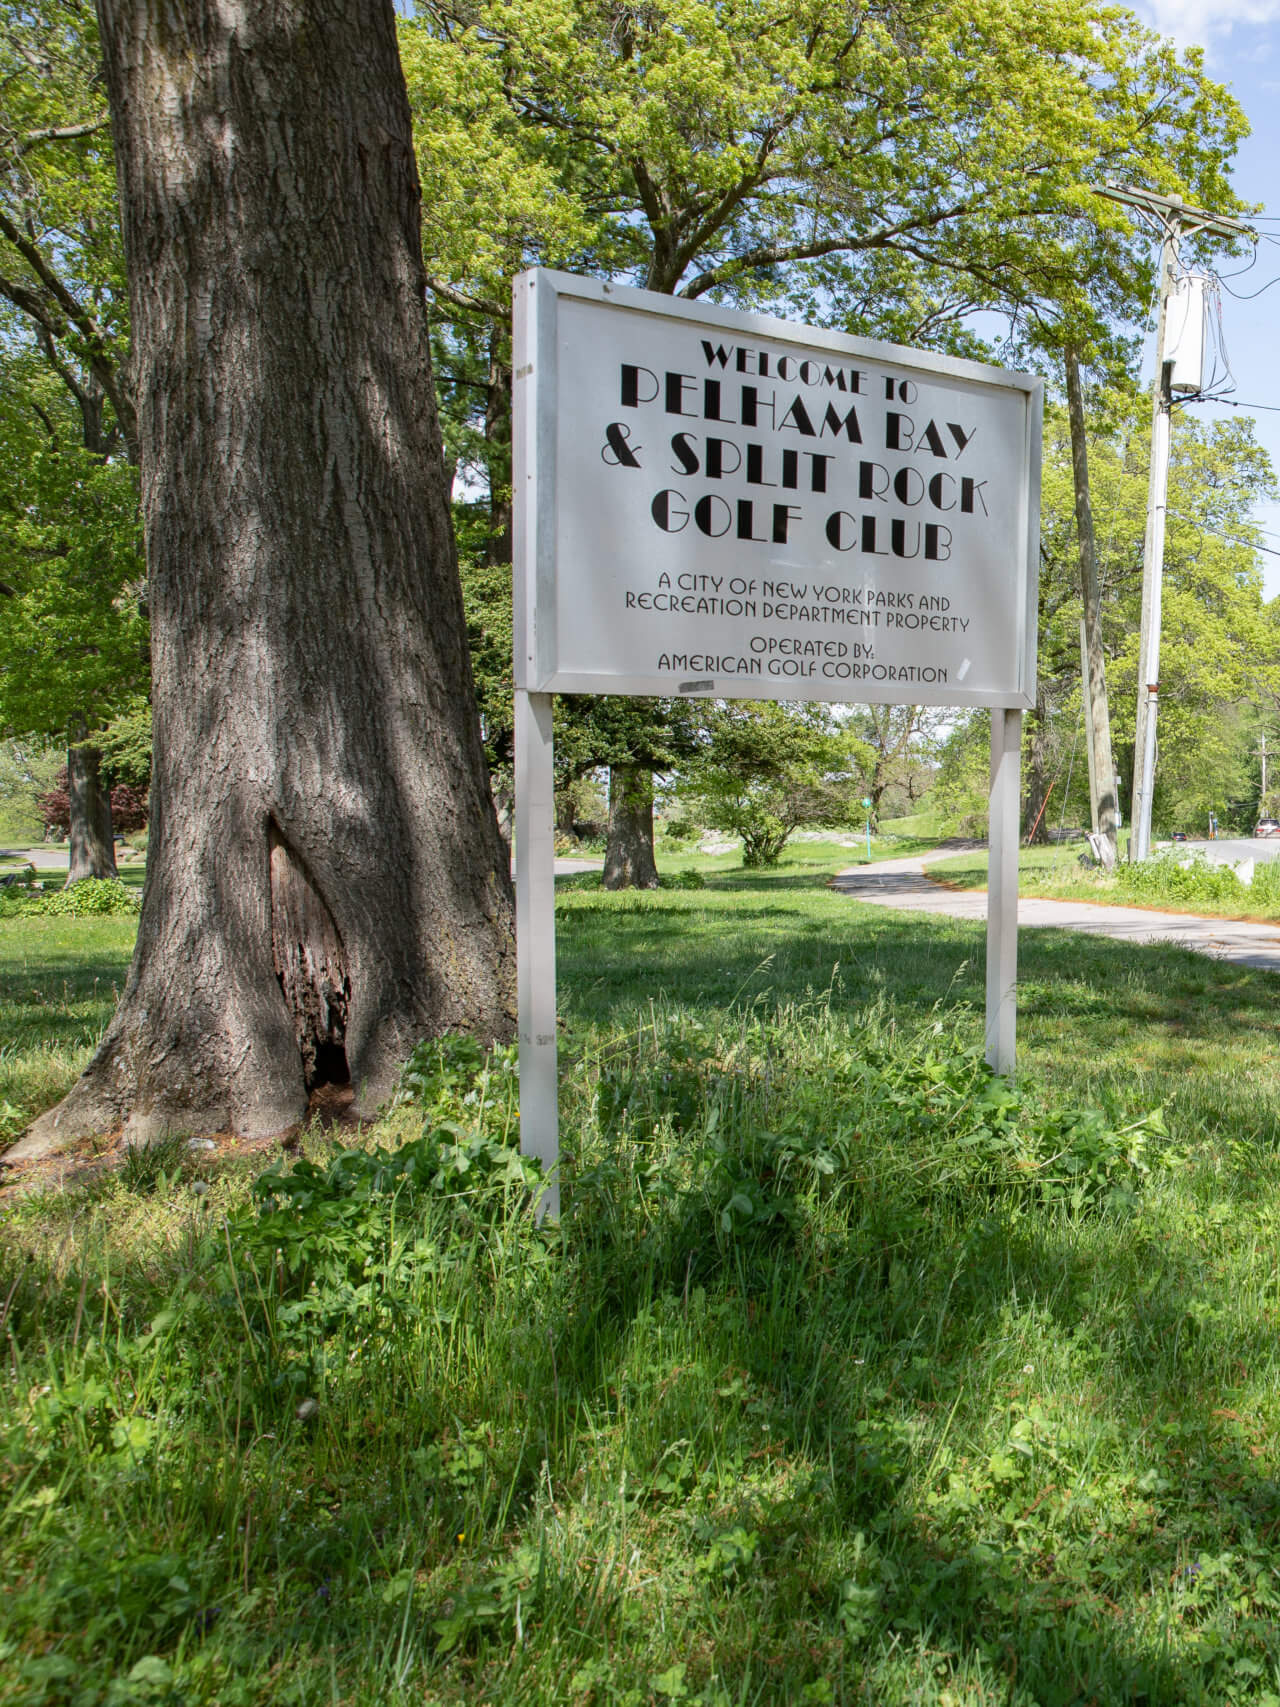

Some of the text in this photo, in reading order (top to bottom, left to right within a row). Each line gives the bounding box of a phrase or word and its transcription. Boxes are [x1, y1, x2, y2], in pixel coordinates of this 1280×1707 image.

[700, 340, 918, 405] WELCOME TO
[621, 363, 977, 461] PELHAM BAY
[601, 422, 989, 517] & SPLIT ROCK
[651, 489, 953, 561] GOLF CLUB
[625, 591, 970, 633] RECREATION DEPARTMENT PROPERTY
[658, 571, 950, 612] A CITY OF NEW YORK PARKS AND
[658, 653, 948, 684] AMERICAN GOLF CORPORATION
[750, 636, 875, 660] OPERATED BY:
